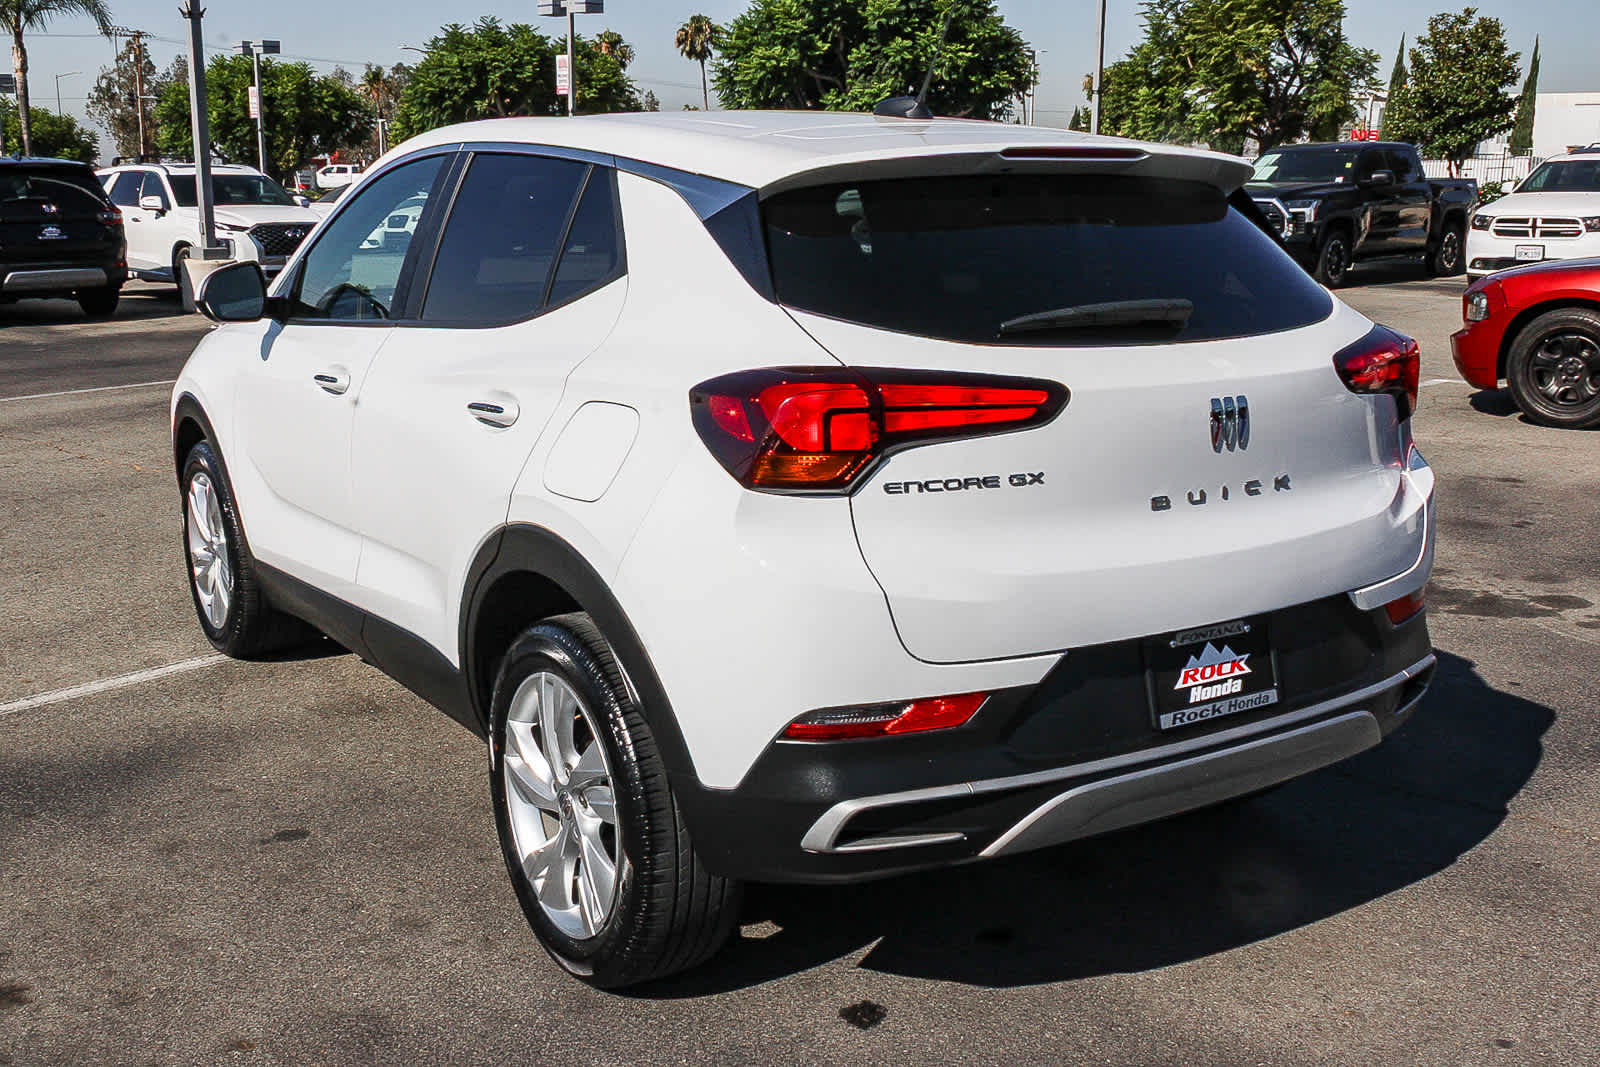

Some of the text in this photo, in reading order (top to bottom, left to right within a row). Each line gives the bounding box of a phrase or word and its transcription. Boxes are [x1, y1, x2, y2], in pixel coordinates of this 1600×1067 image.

[883, 471, 1045, 495] ENCORE GX
[1151, 474, 1292, 512] BUICK
[1179, 623, 1244, 644] FONTANA
[1182, 659, 1245, 684] ROCK
[1189, 678, 1243, 704] Honda
[1171, 694, 1270, 726] Rock Honda
